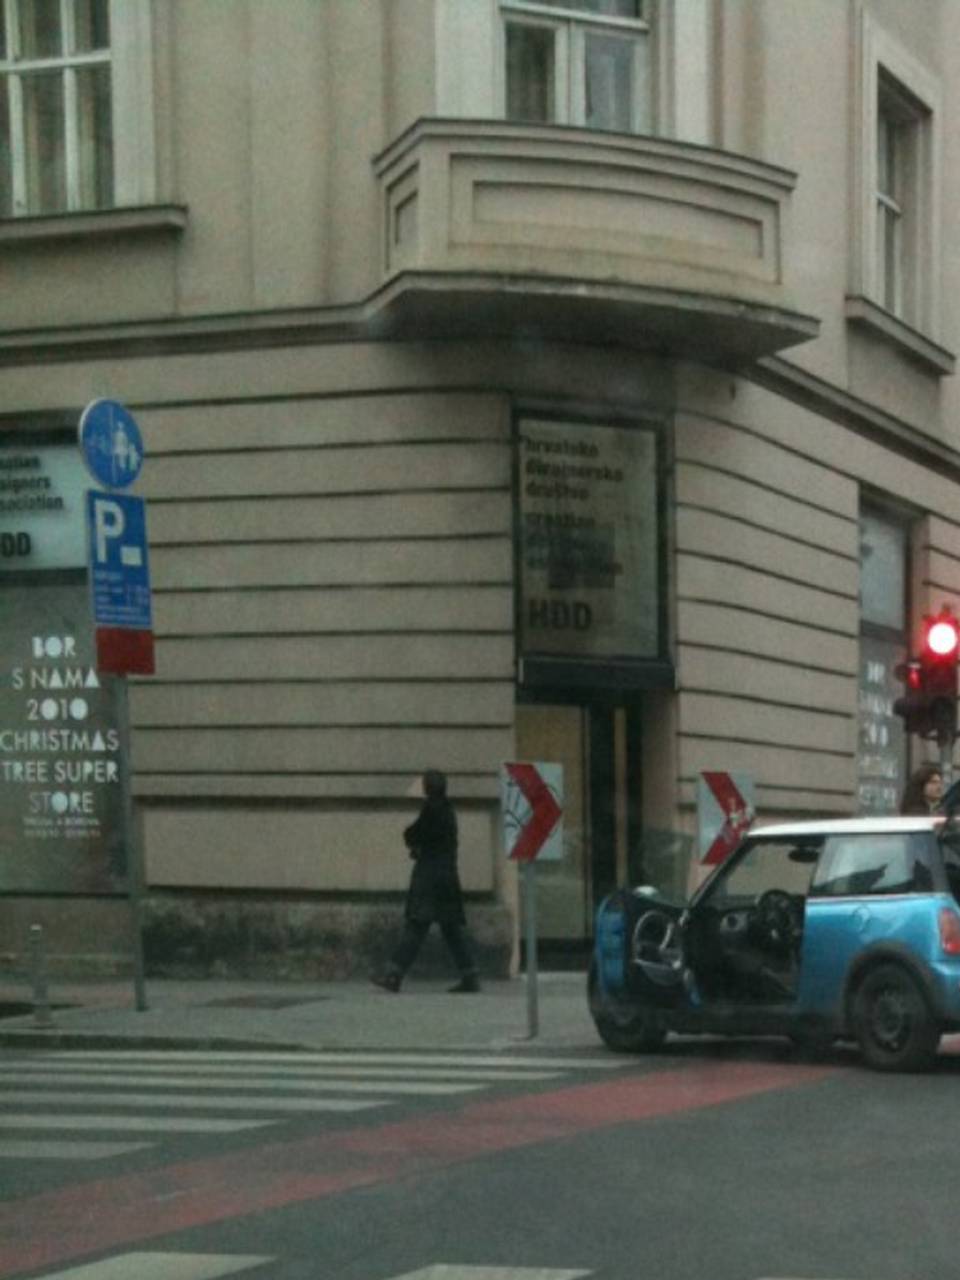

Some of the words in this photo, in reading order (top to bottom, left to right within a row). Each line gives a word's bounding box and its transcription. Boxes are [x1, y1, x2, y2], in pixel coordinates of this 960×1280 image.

[95, 499, 124, 563] P
[32, 636, 77, 659] BOR
[31, 667, 101, 689] NAMA
[27, 698, 89, 720] 2010
[0, 730, 120, 752] CHRISTMAS
[2, 761, 48, 783] TREE
[54, 761, 119, 783] SUPER
[29, 791, 94, 813] STORE
